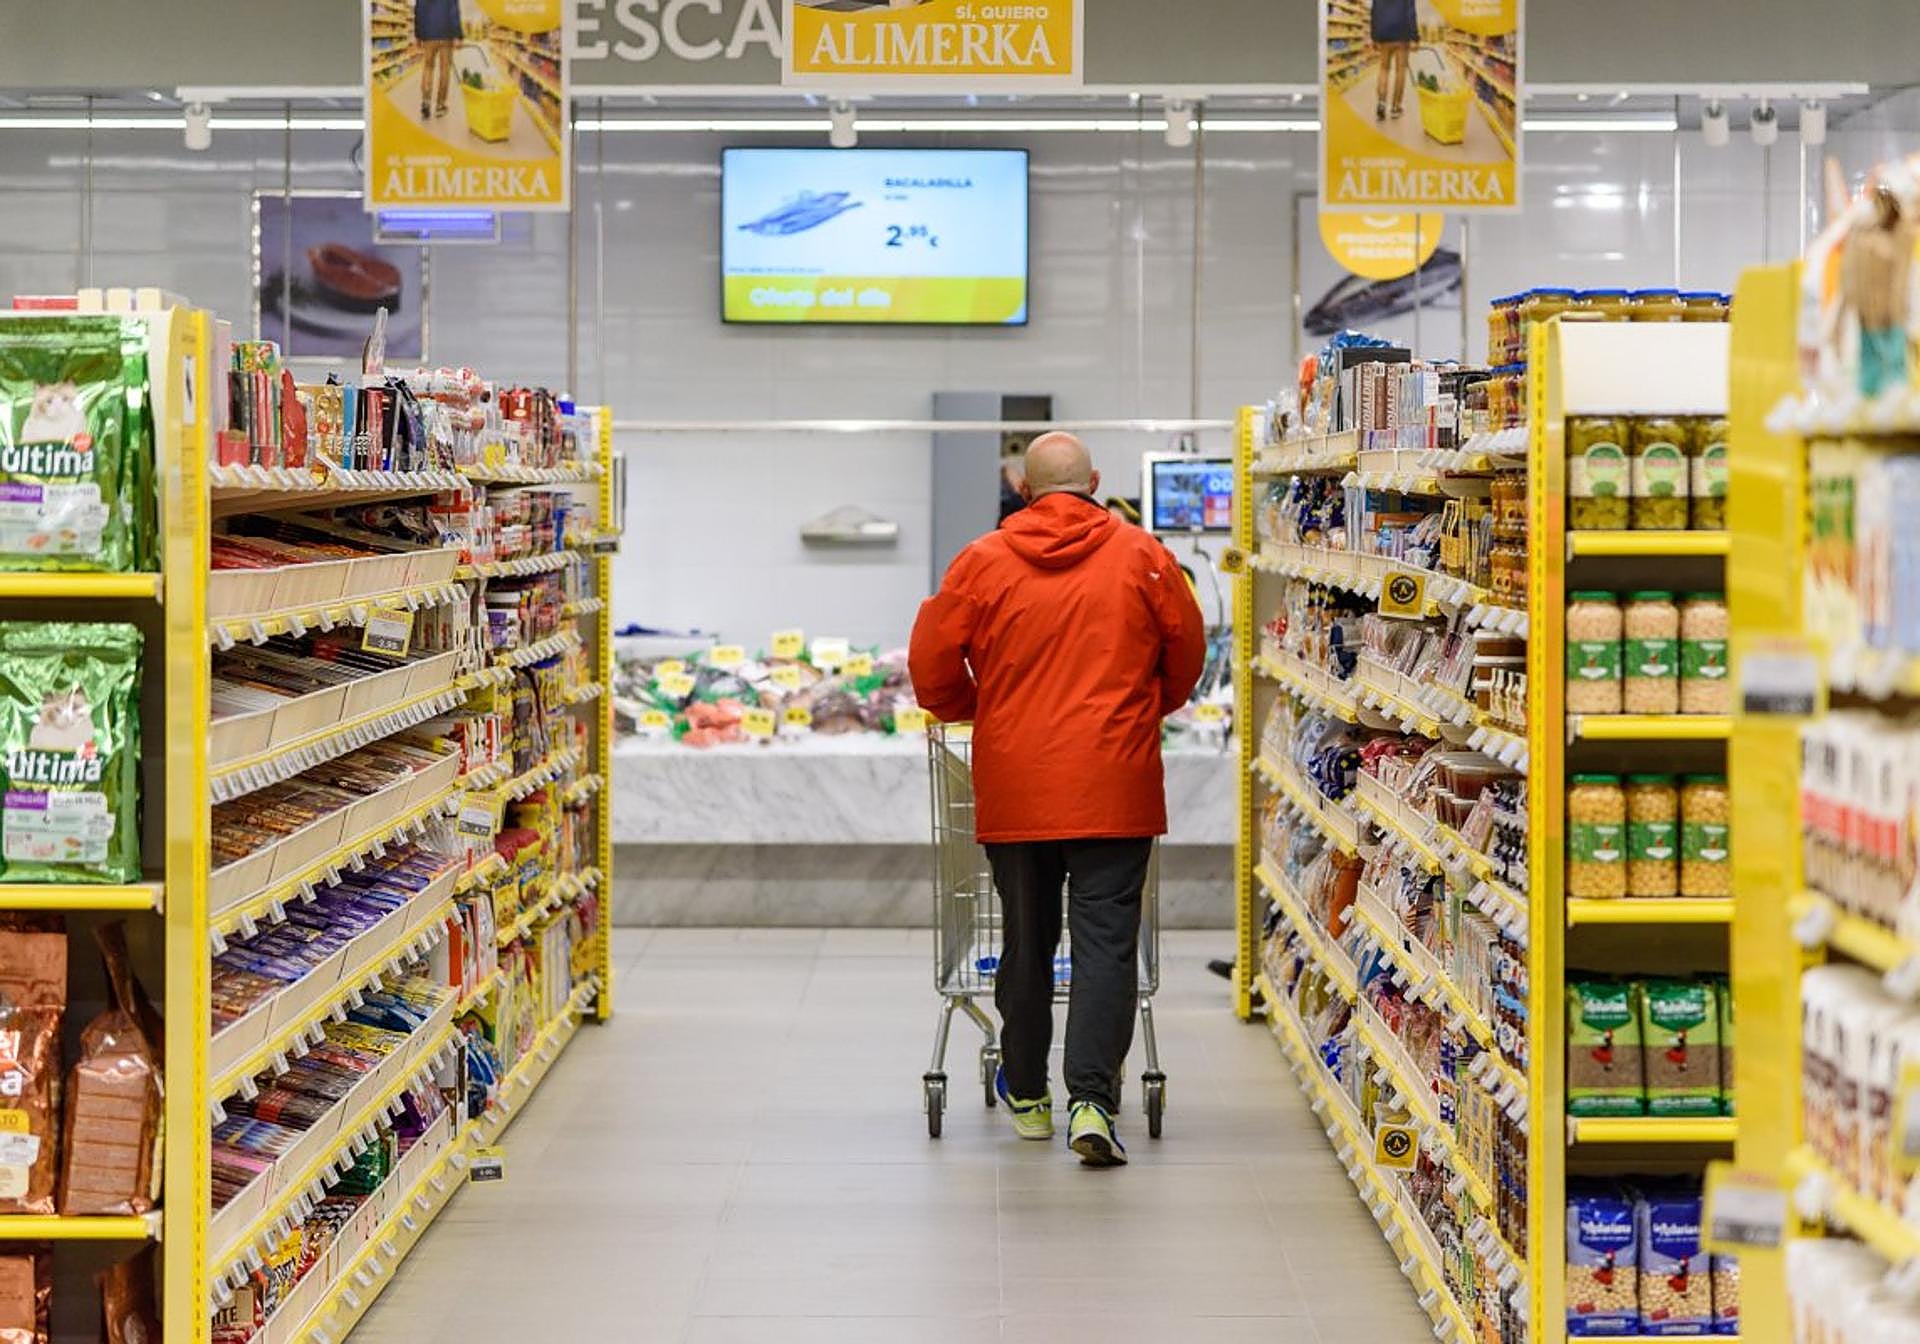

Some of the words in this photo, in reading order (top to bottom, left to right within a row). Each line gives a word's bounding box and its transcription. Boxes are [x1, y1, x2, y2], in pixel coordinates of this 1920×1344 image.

[981, 7, 1048, 20] QUIERO
[809, 22, 1055, 67] ALIMERKA
[383, 166, 551, 197] ALIMERKA
[1337, 169, 1504, 200] ALIMERKA
